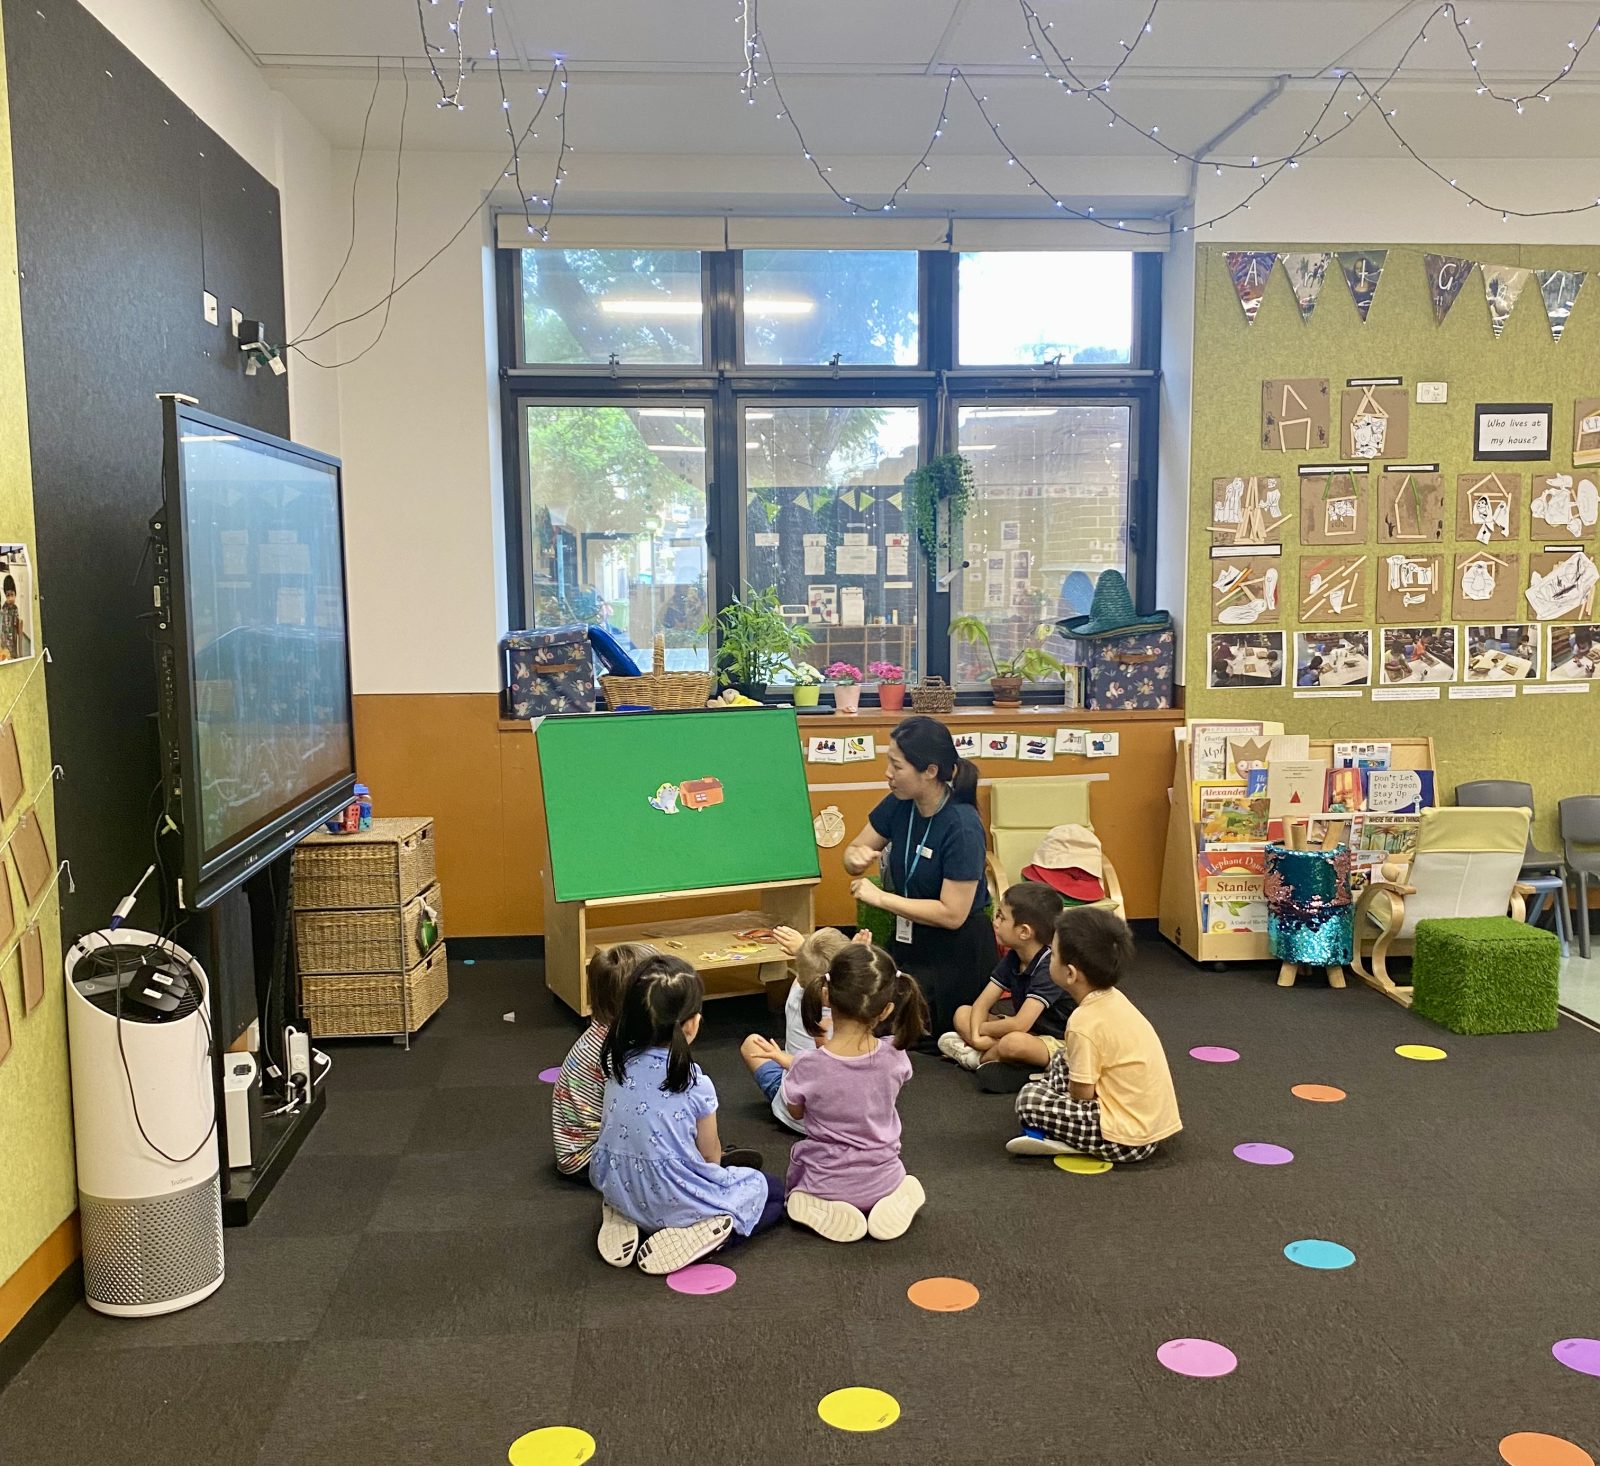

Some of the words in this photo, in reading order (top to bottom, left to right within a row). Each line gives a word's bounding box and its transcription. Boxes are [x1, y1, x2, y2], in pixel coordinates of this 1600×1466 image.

[1487, 419, 1505, 428] Who
[1510, 419, 1528, 428] lives
[1491, 438, 1503, 446] my
[1508, 436, 1537, 444] house?
[1374, 774, 1396, 782] Don't
[1391, 782, 1417, 790] Pigeon
[1396, 791, 1407, 799] Up
[1206, 857, 1242, 875] Elephant
